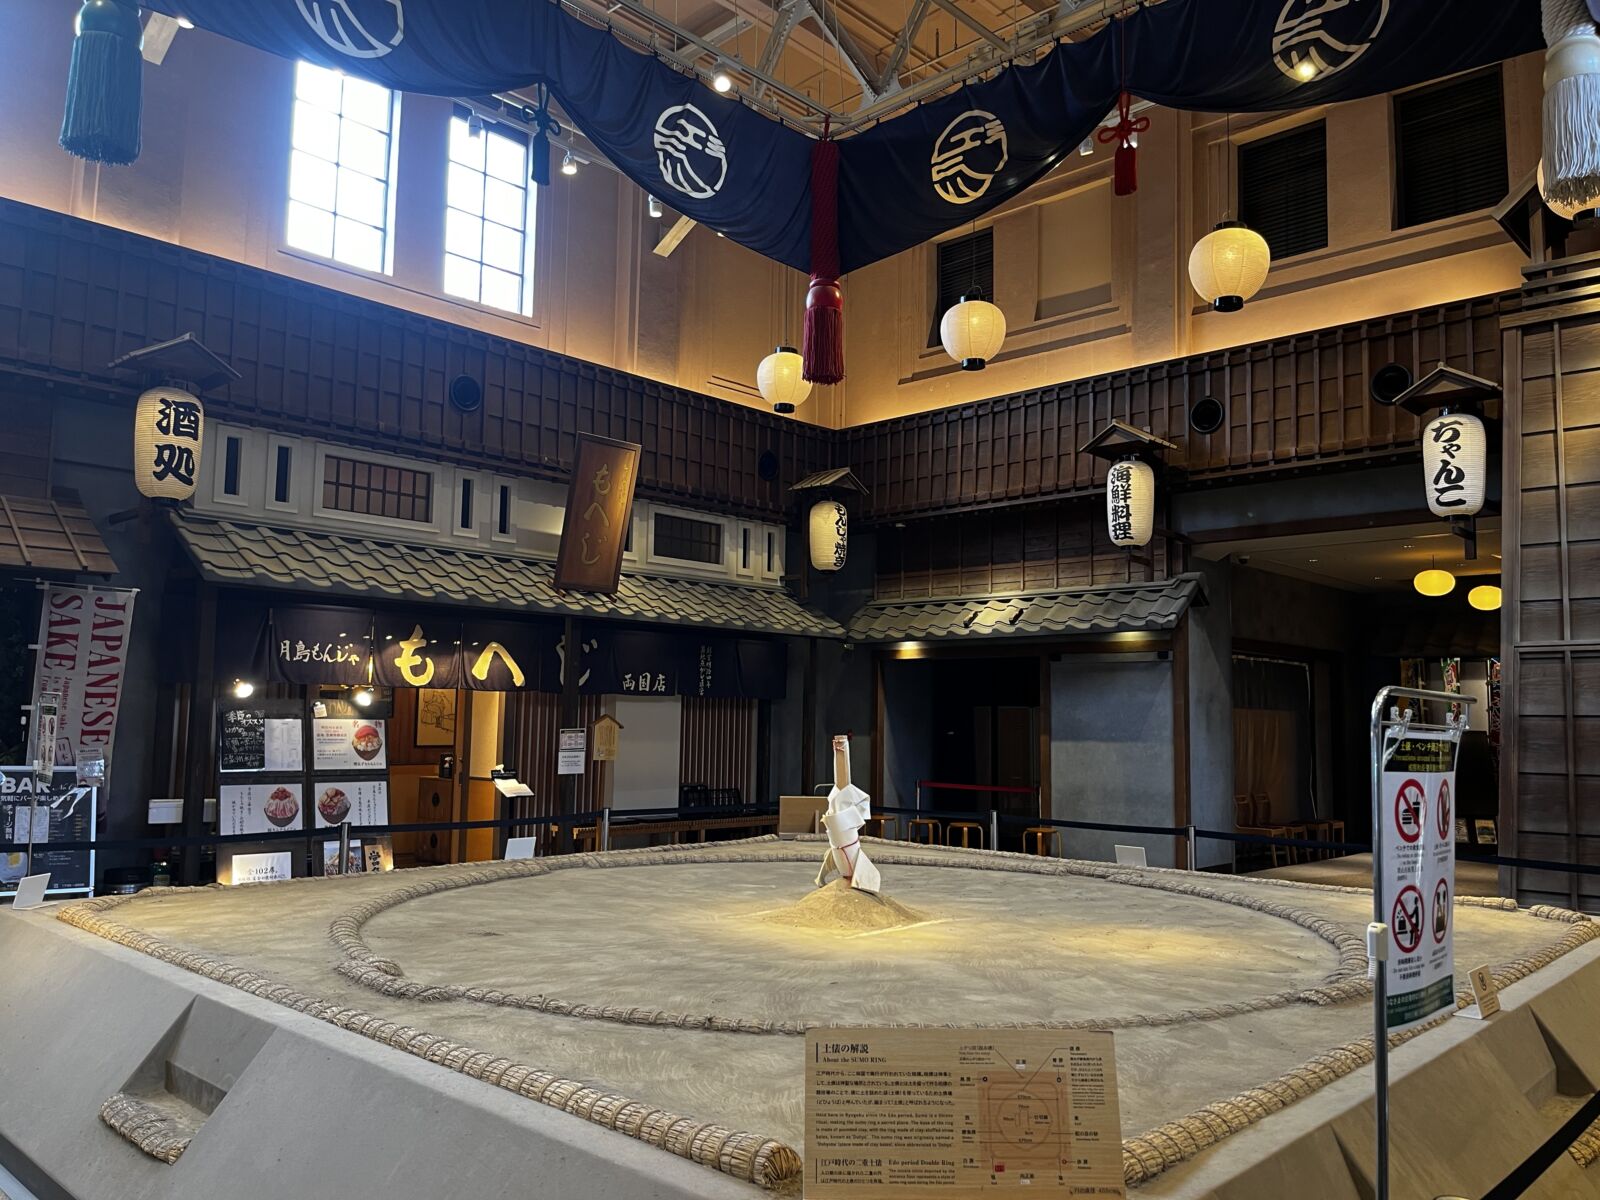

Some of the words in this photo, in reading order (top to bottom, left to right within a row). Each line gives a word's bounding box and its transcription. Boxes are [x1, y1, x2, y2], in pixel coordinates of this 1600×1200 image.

[152, 398, 200, 486] 酒処
[1430, 420, 1467, 507] ちゃんこ
[581, 463, 612, 566] もへじ
[833, 503, 847, 567] もんじゃ焼き
[1111, 464, 1134, 541] 海鮮料理
[43, 592, 83, 671] SAKE
[279, 640, 360, 666] 月島もんじゃ
[79, 596, 127, 745] JAPANESE
[622, 672, 666, 692] 両国店
[823, 1043, 869, 1055] 土俵の解説
[820, 1158, 882, 1167] 江戸時代の二重土俵
